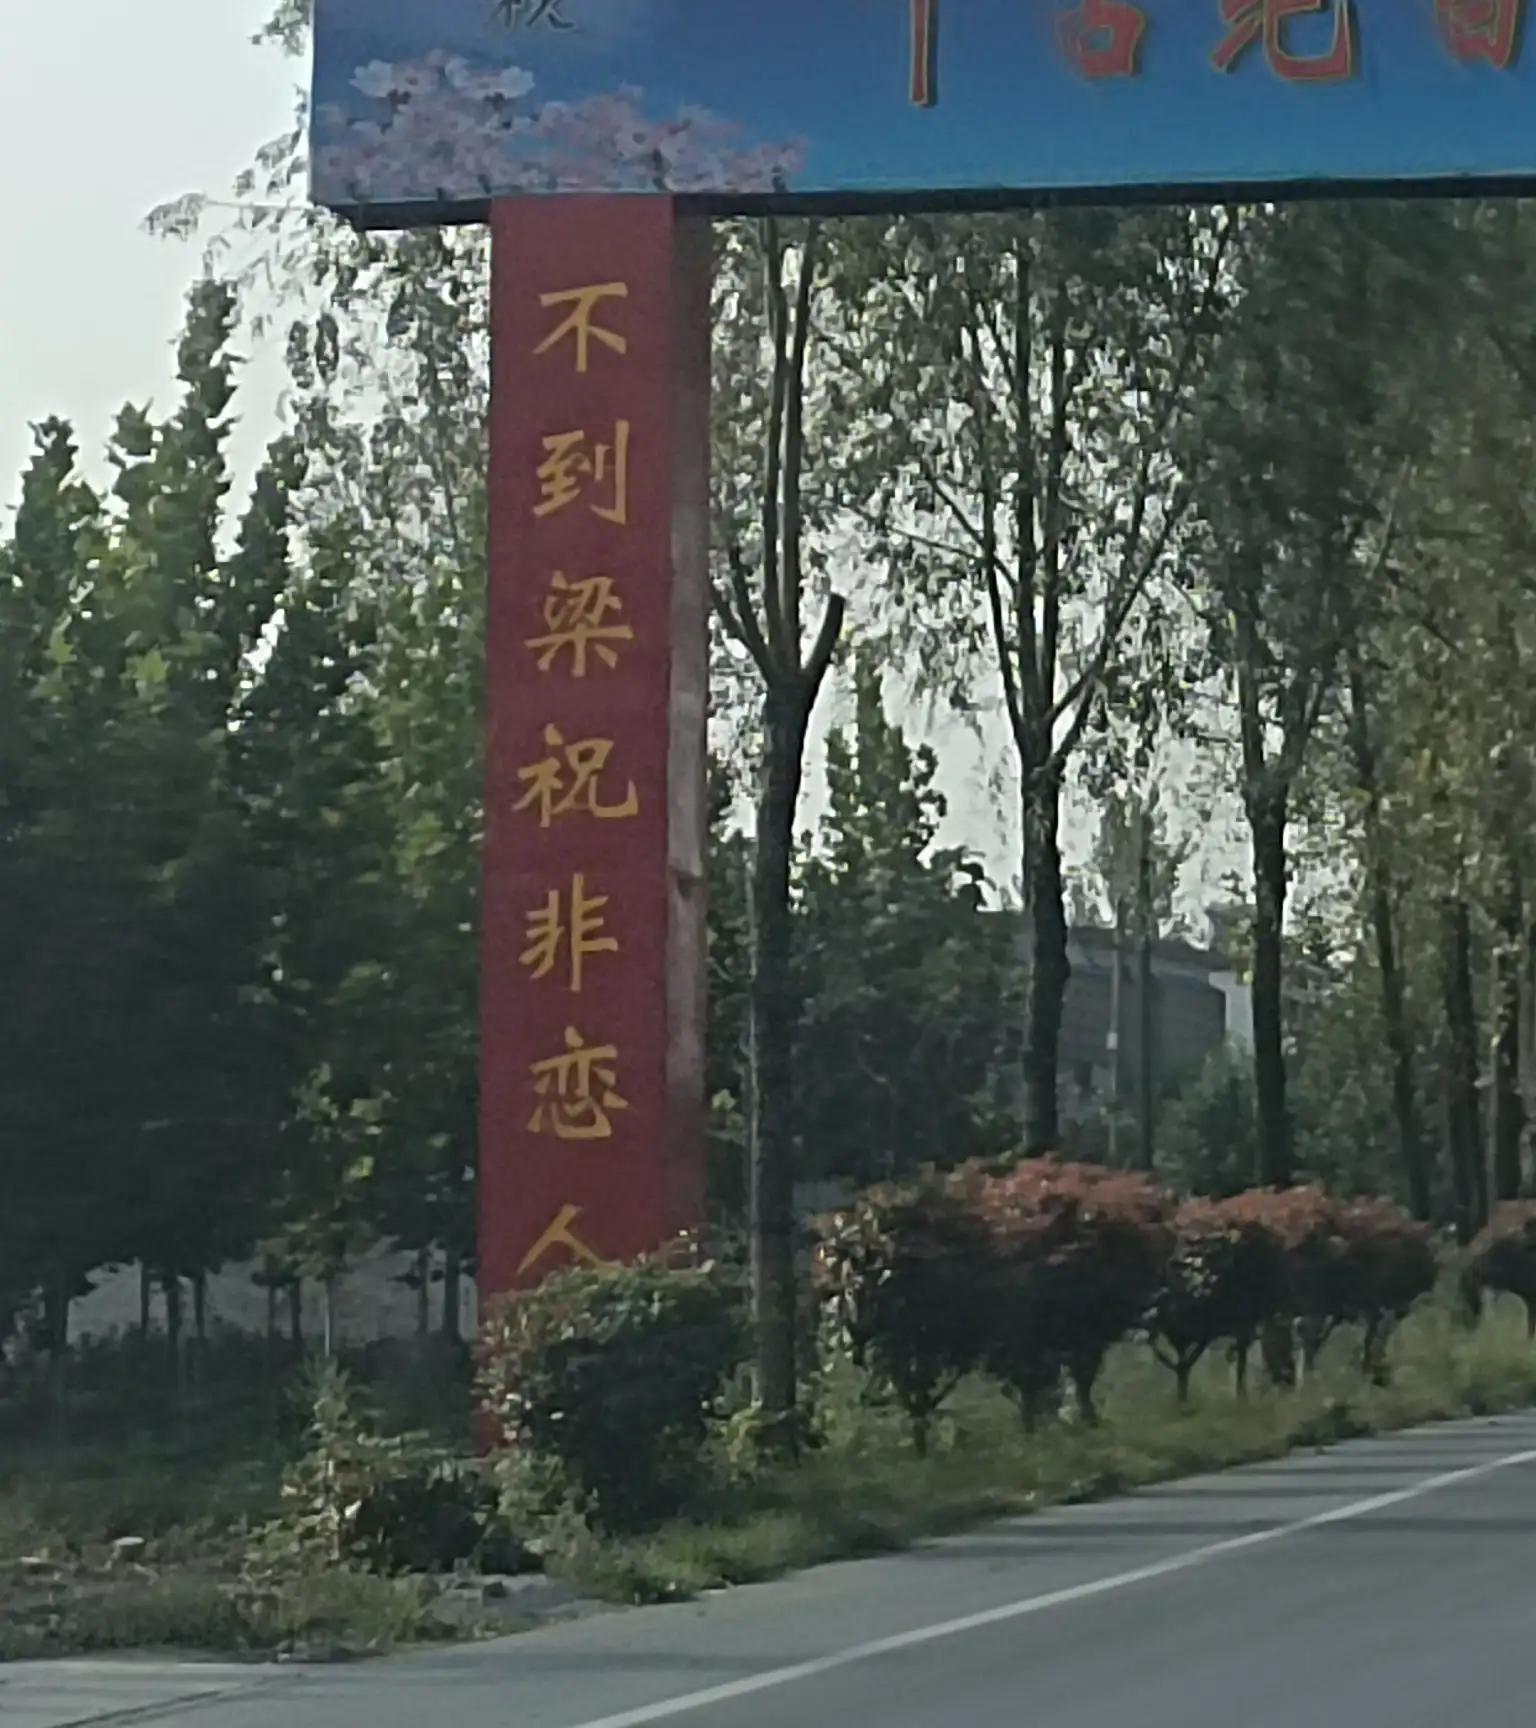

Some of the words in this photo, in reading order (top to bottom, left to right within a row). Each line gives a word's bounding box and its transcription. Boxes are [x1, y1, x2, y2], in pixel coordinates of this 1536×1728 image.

[512, 282, 639, 1274] 不到梁祝非恋人
